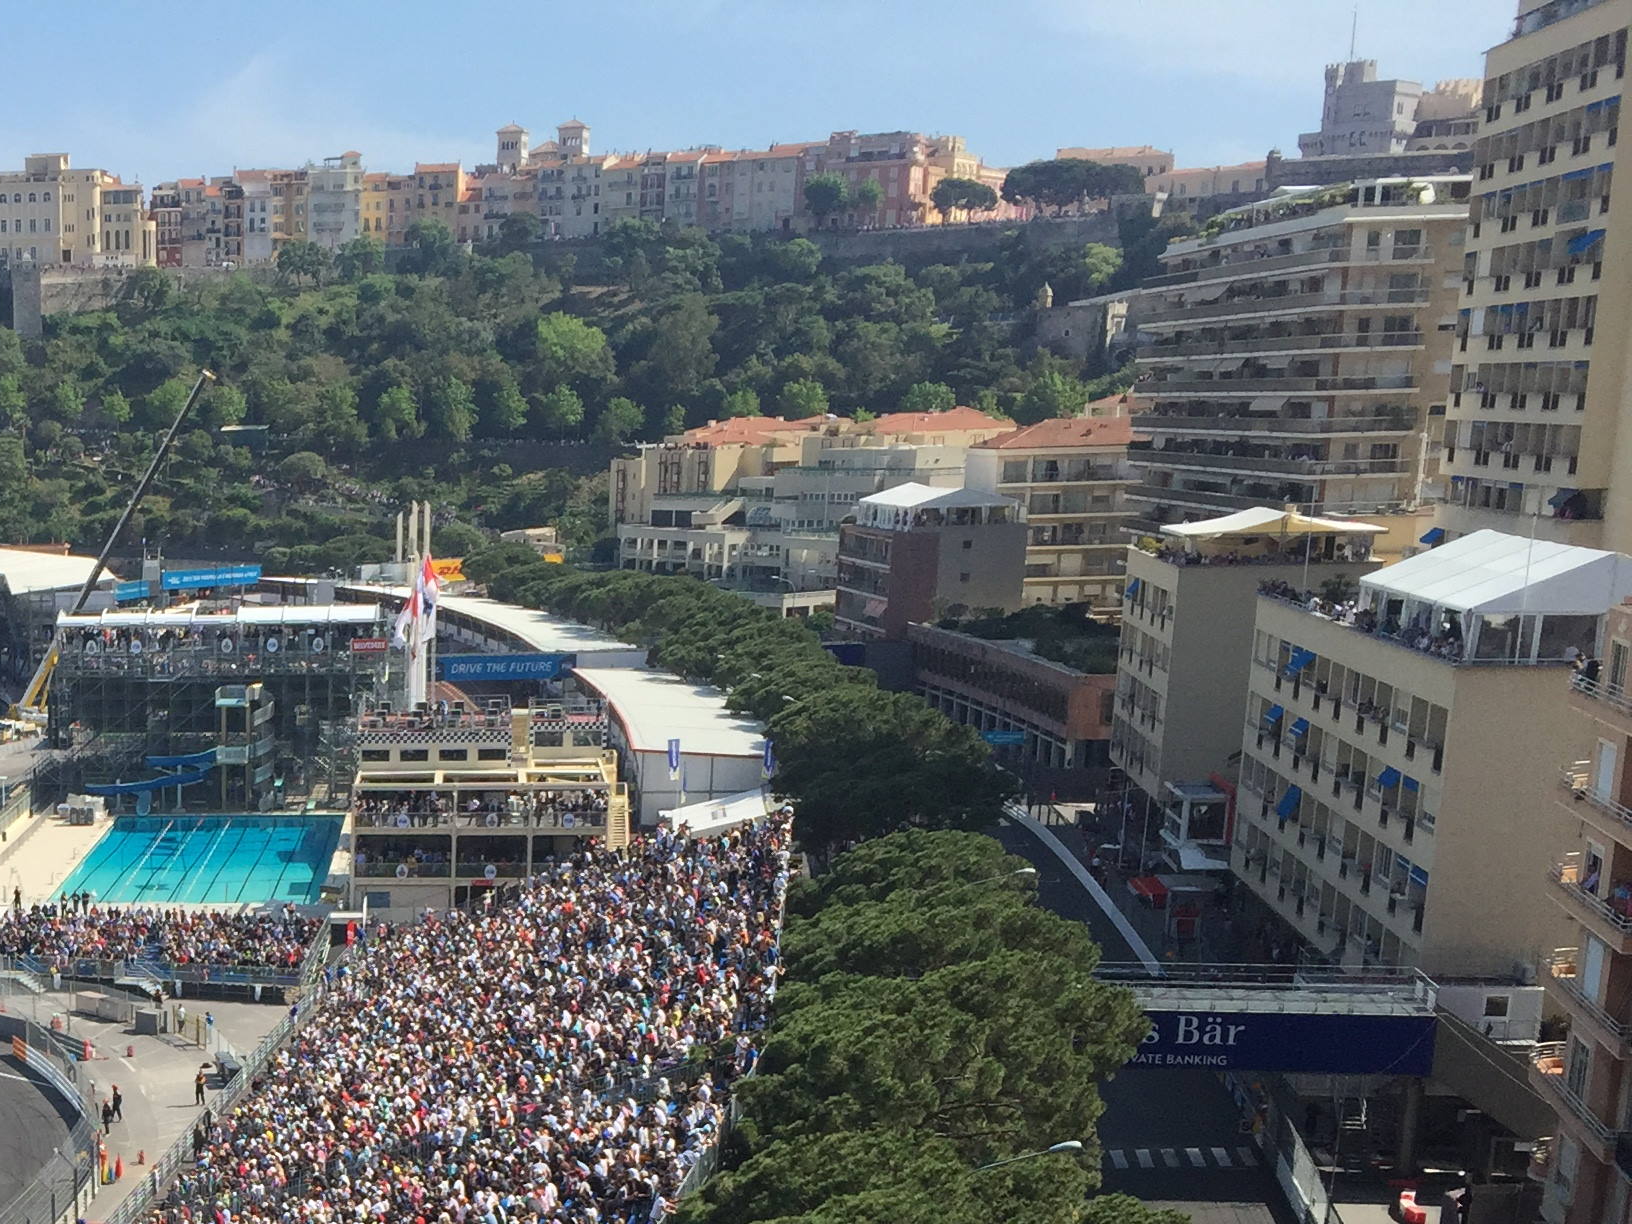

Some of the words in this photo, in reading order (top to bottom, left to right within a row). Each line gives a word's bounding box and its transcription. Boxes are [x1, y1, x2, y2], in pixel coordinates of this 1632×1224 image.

[451, 663, 483, 674] DRIVE
[487, 662, 507, 673] THE
[509, 661, 553, 673] FUTURE
[1175, 1015, 1246, 1045] Bär
[1166, 1054, 1228, 1066] BANKING
